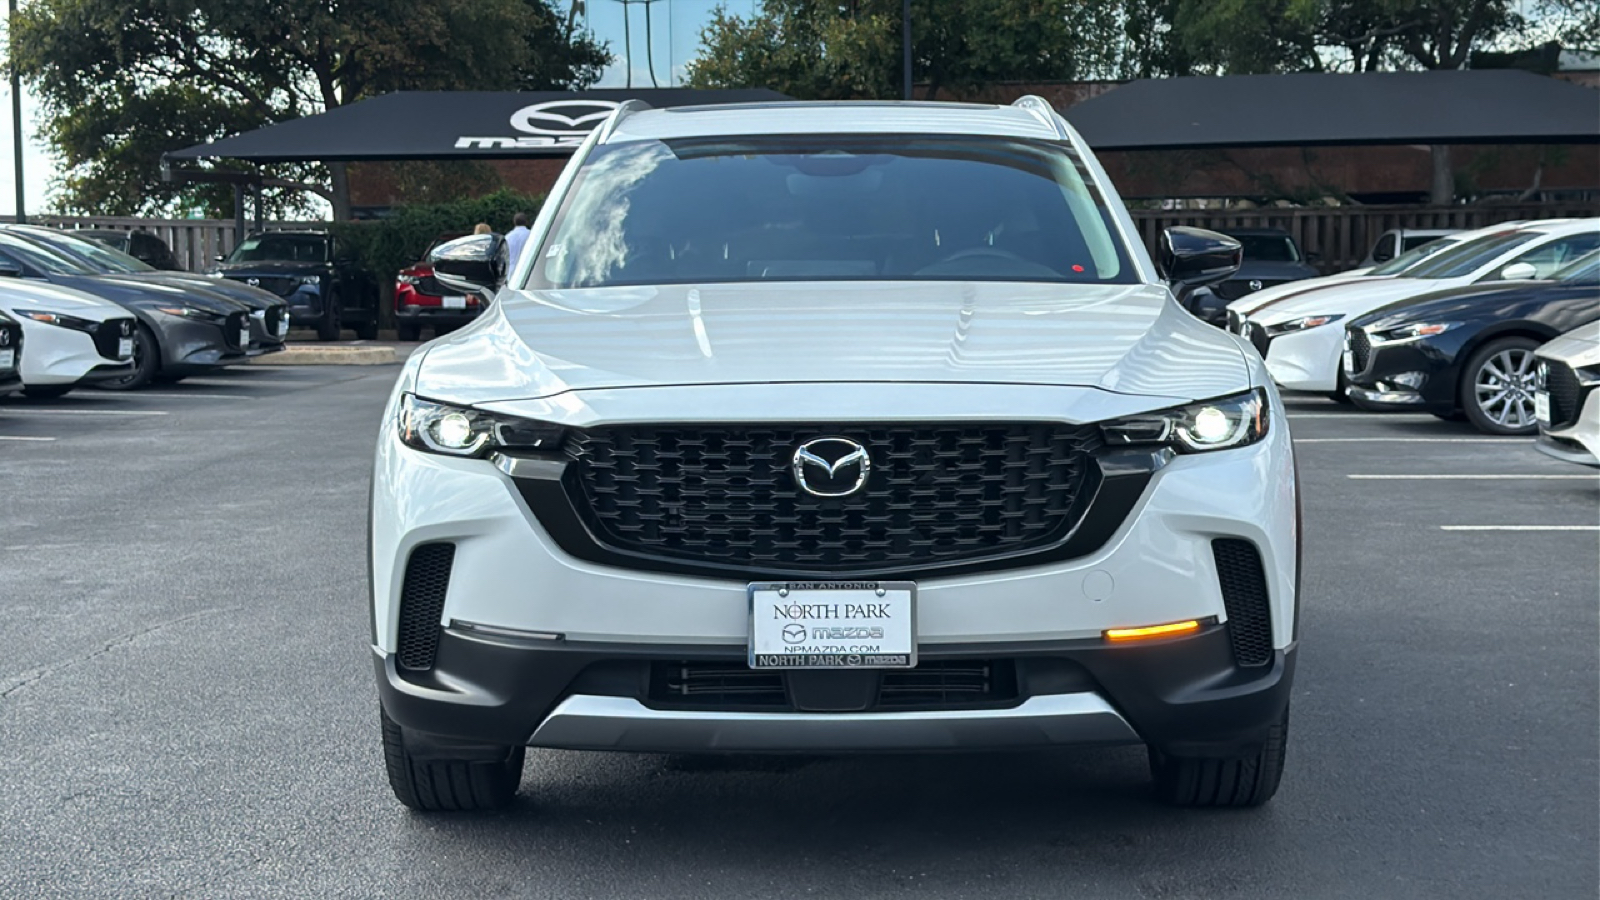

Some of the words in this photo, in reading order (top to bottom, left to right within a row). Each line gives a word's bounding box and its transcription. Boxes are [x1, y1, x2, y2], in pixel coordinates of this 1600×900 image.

[789, 582, 815, 590] SAN
[818, 582, 877, 590] ANTONIO
[773, 603, 839, 620] NORTH
[844, 603, 891, 619] PARK
[812, 626, 884, 639] mazda
[759, 655, 805, 666] NORTH
[808, 655, 845, 666] PARK
[864, 655, 906, 664] mazda
